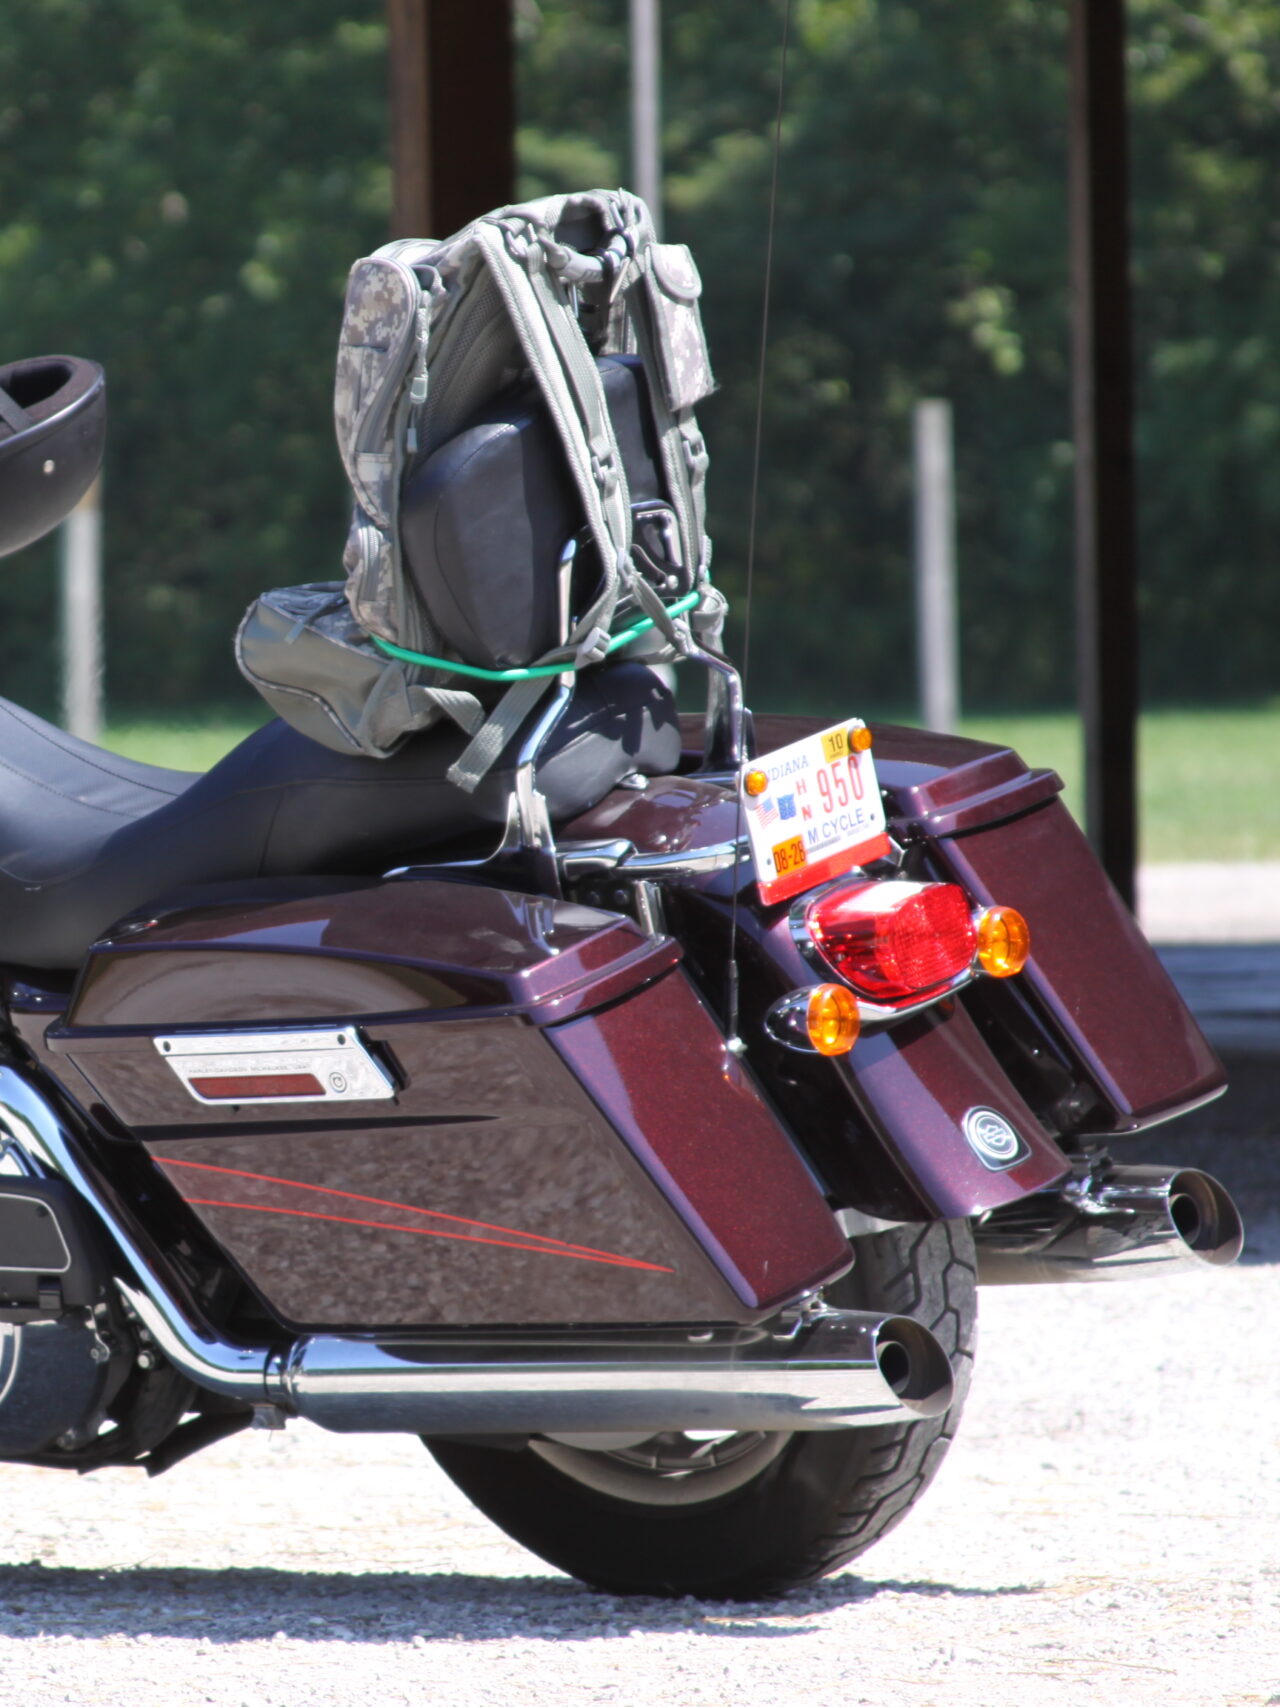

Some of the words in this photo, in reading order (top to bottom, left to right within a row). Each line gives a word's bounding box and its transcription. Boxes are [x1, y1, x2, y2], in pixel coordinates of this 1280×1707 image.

[828, 732, 844, 752] 10
[767, 754, 809, 782] DIANA
[795, 778, 807, 796] H
[816, 755, 864, 814] 950
[801, 803, 813, 821] N
[807, 827, 819, 846] M
[822, 807, 866, 838] CYCLE
